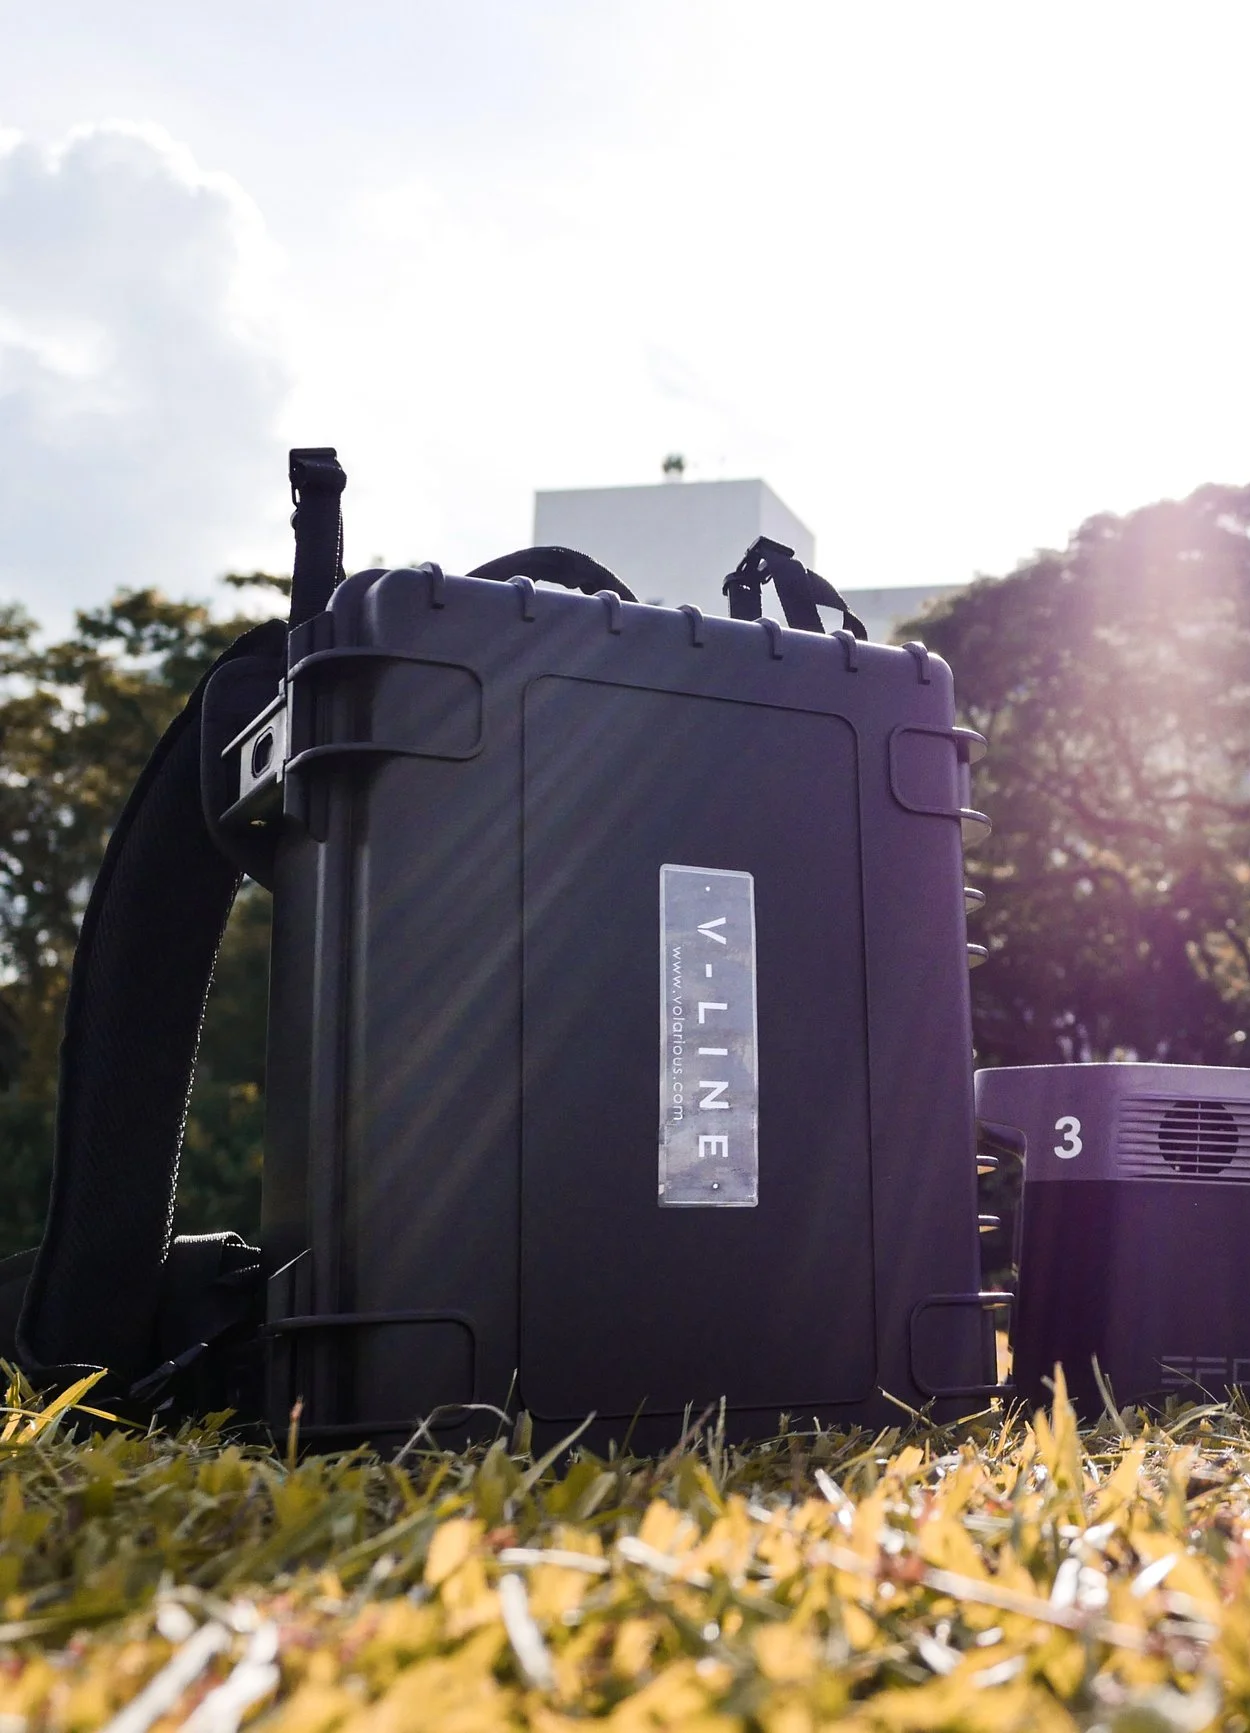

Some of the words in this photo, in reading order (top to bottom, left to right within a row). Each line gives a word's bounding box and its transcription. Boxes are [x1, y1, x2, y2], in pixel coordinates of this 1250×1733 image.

[671, 946, 684, 1121] www.volarious.com
[697, 917, 729, 1158] V-LINE
[1053, 1115, 1083, 1159] 3
